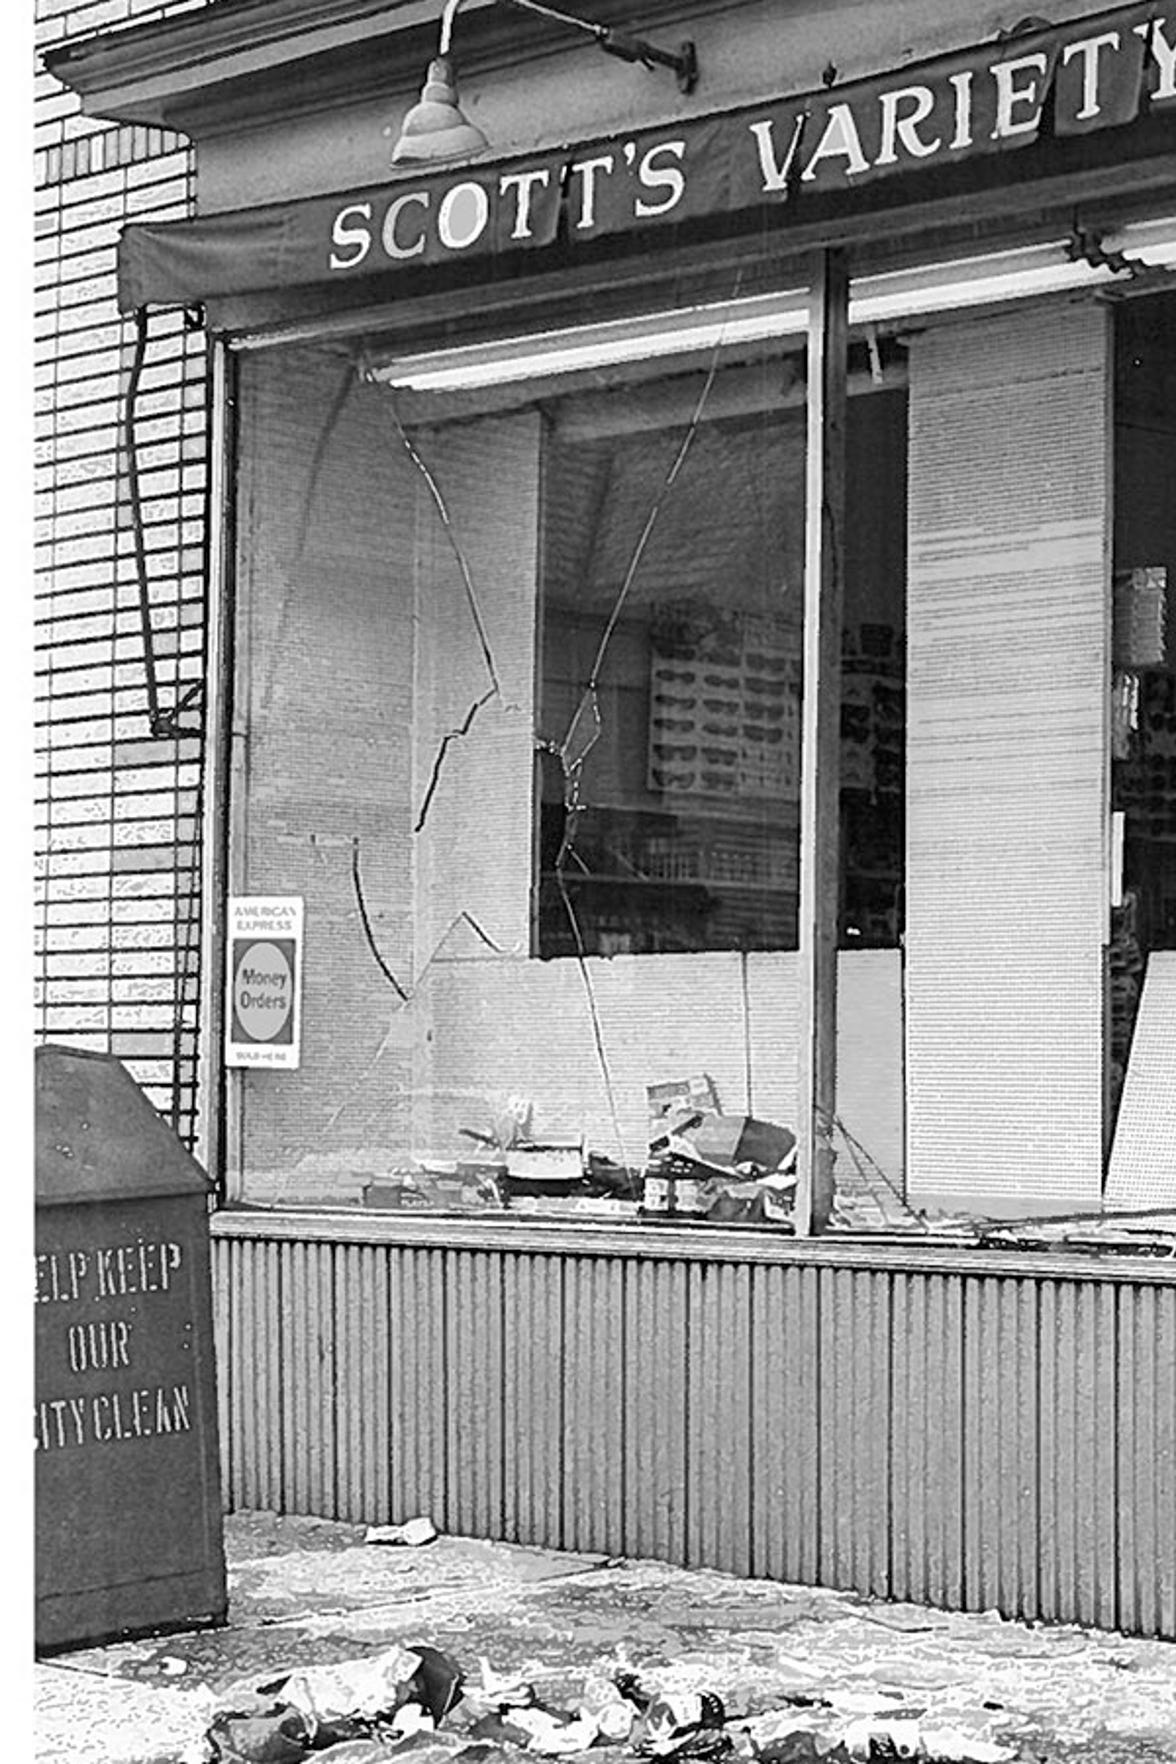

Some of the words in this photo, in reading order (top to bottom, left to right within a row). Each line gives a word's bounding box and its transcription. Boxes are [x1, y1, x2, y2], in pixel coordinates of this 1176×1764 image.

[329, 140, 687, 270] SCOTT'S
[240, 991, 287, 1010] Orders
[242, 968, 288, 990] Money
[98, 1243, 181, 1297] KEEP
[69, 1321, 129, 1372] OUR
[35, 1398, 85, 1450] ITY
[93, 1386, 190, 1440] CLEAN
